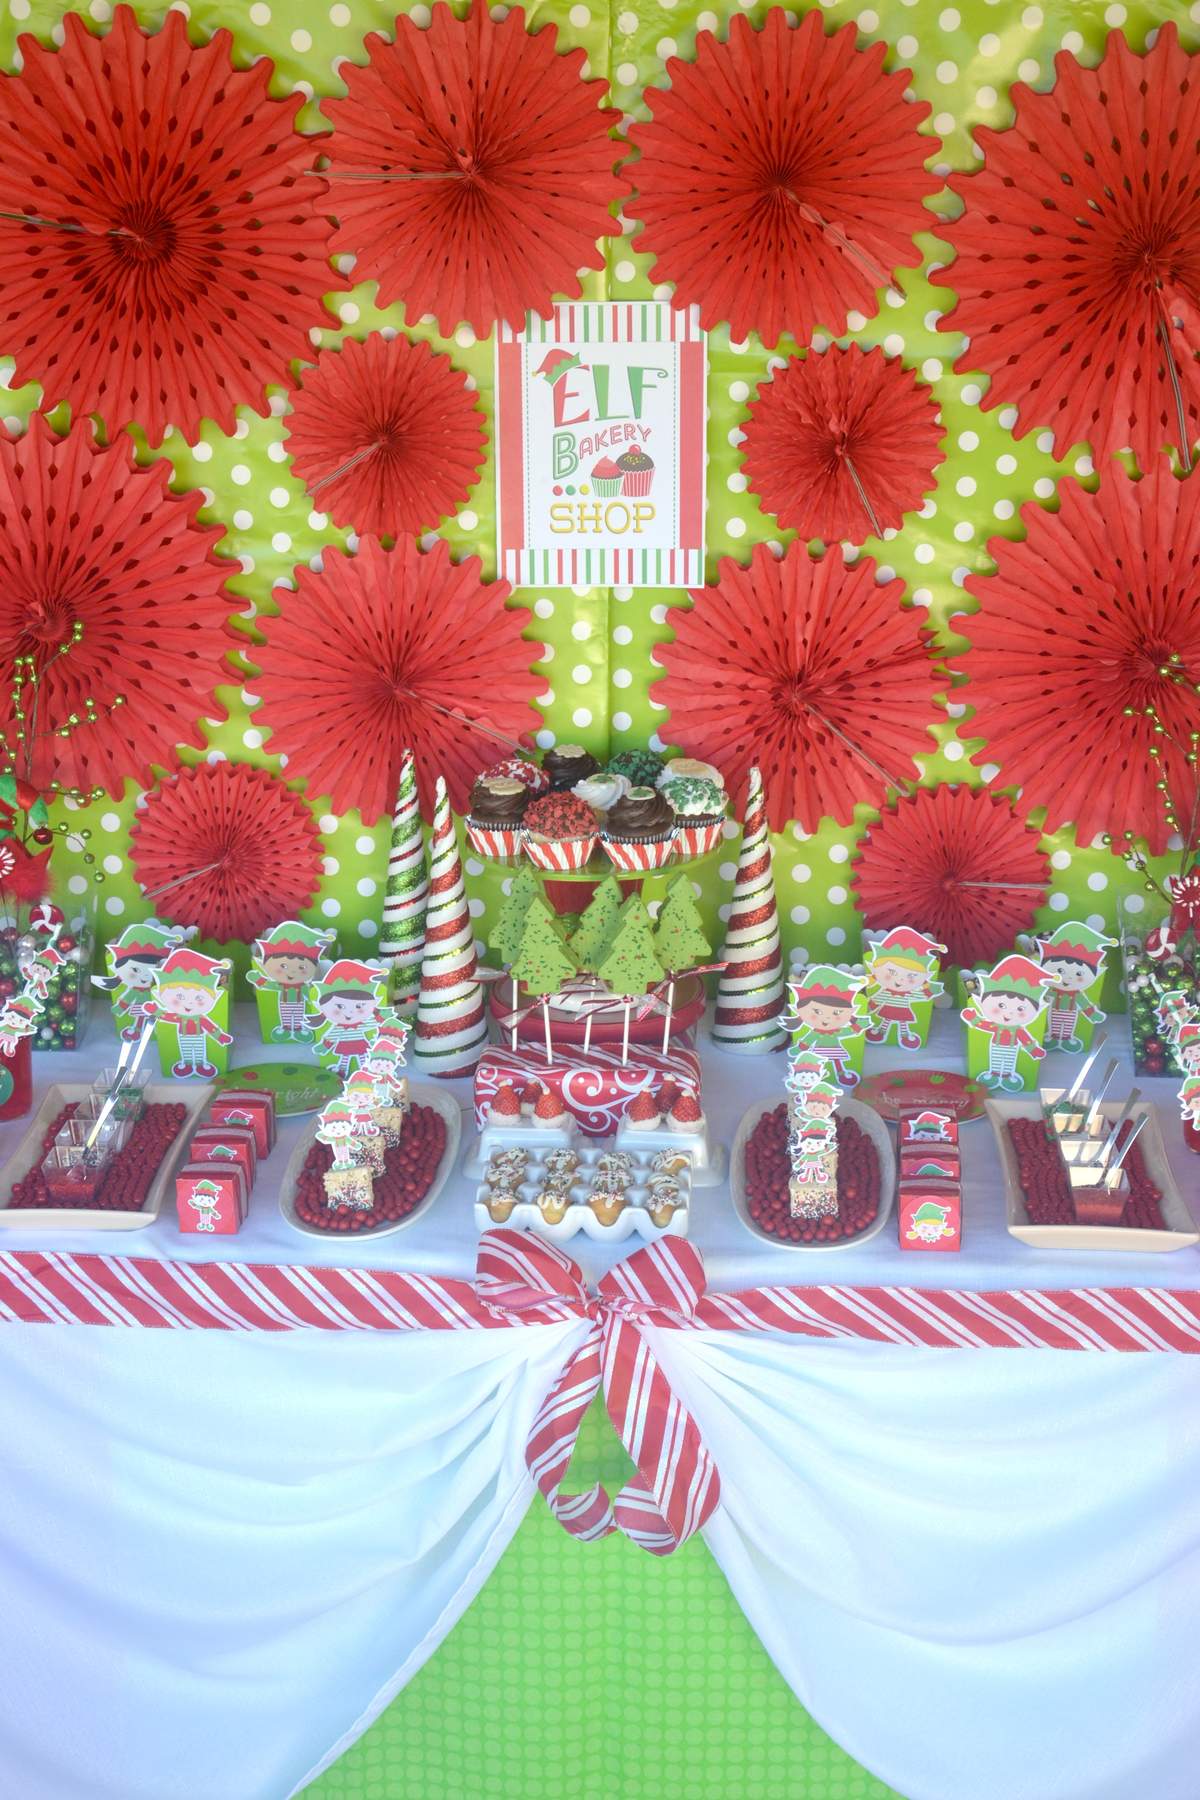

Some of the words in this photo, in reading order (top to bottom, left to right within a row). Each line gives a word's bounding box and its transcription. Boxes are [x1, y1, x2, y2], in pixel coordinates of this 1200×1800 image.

[552, 364, 669, 428] ELF
[552, 423, 653, 481] BAKERY
[549, 501, 656, 535] SHOP
